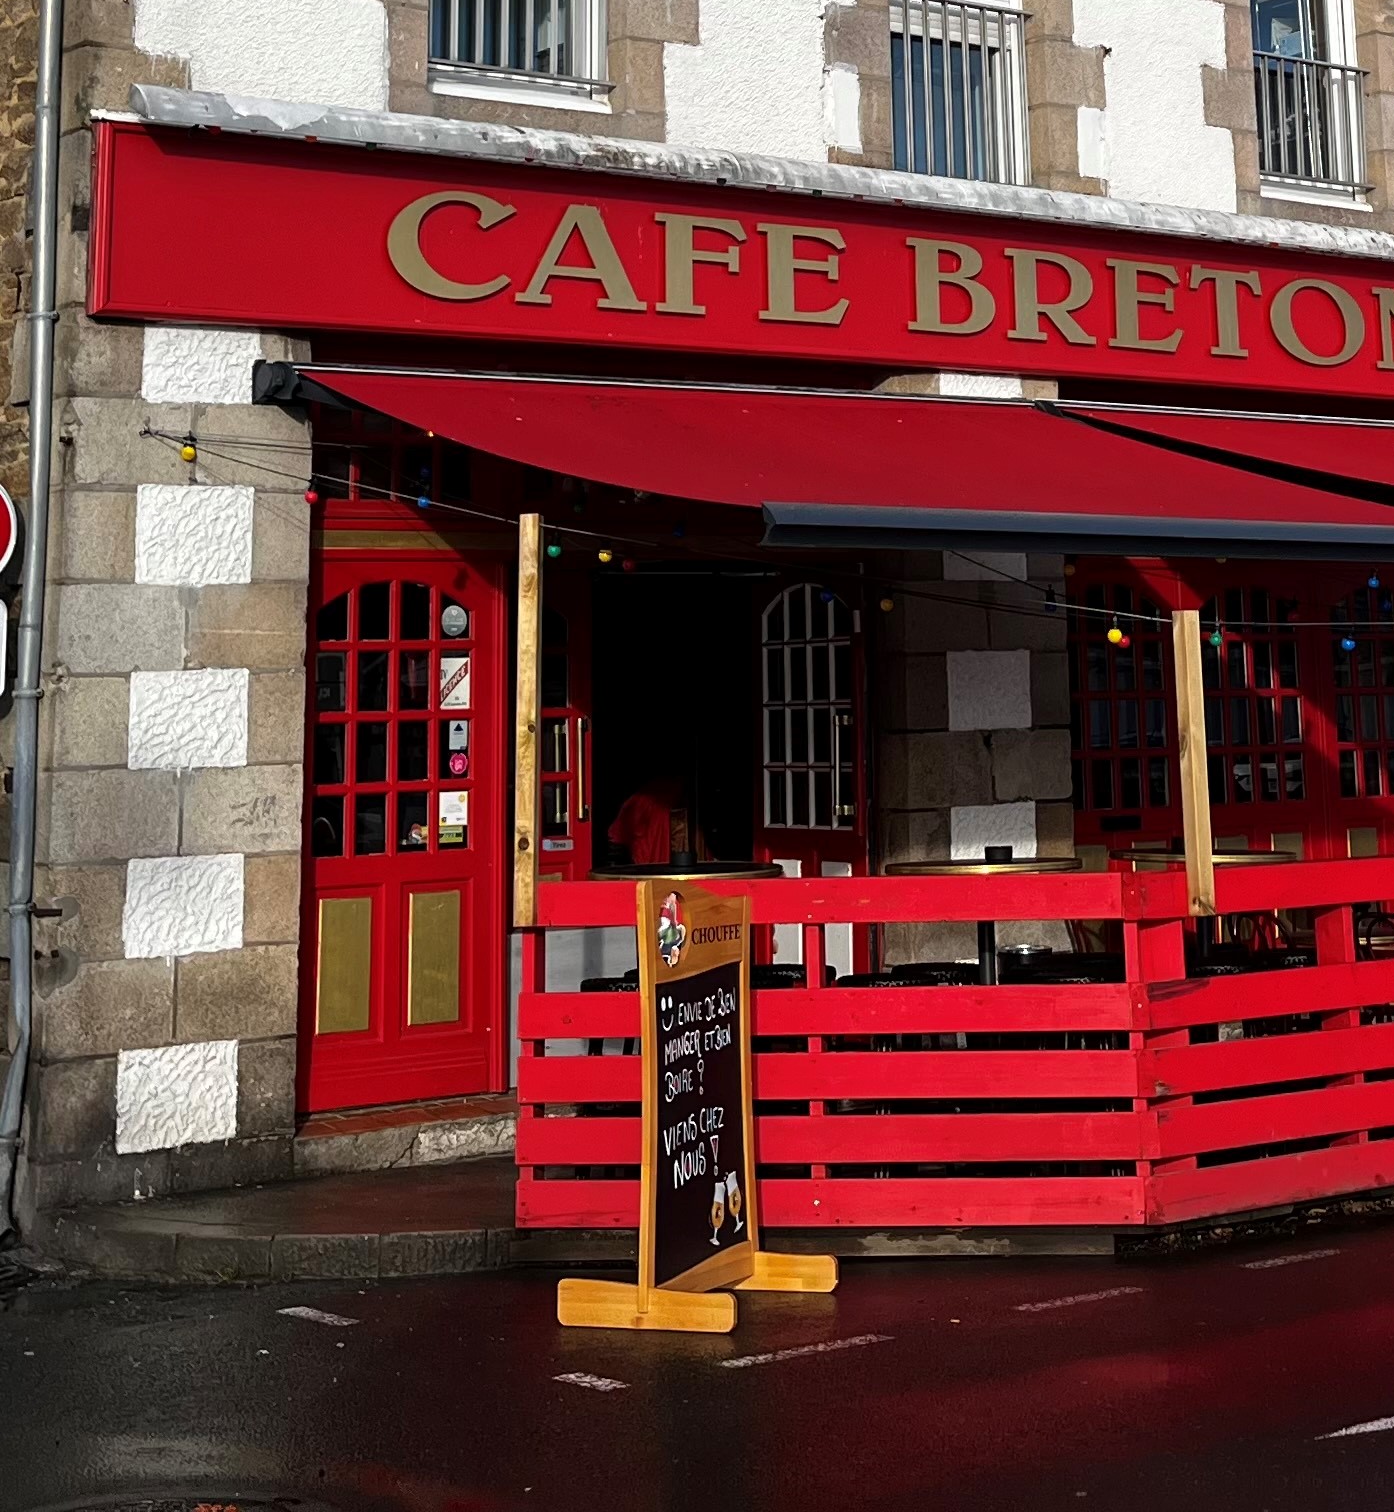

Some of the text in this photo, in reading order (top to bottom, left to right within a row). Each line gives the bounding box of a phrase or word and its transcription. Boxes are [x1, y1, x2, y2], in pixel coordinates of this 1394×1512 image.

[385, 190, 851, 326] CAFE
[691, 923, 741, 945] CHOUFFE
[664, 1029, 702, 1066] MANGER
[664, 1068, 693, 1102] BOIRE
[663, 1106, 725, 1157] VIENS CHEZ
[674, 1141, 707, 1190] NOUS
